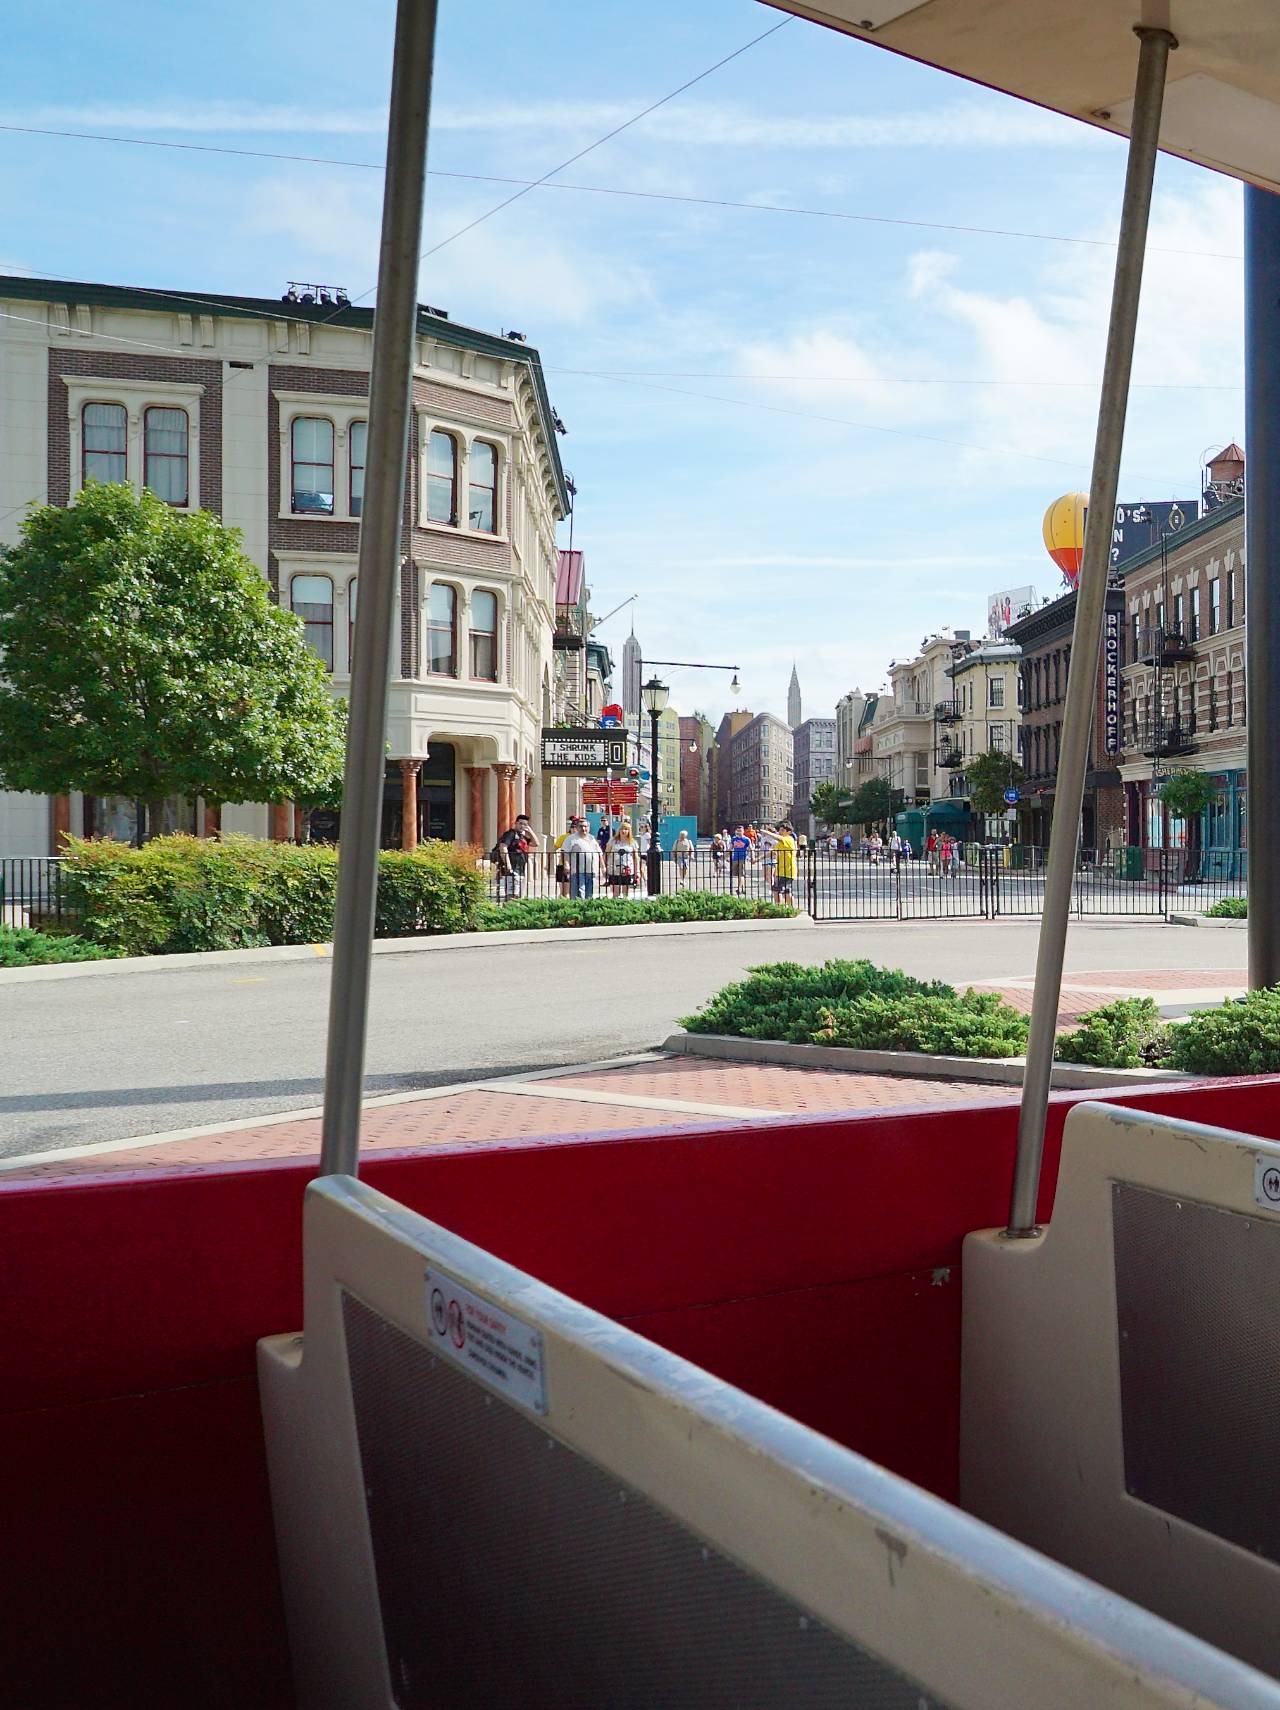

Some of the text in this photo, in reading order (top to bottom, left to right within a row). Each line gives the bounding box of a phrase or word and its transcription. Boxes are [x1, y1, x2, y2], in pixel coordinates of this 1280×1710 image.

[1107, 614, 1117, 748] BROCKERHOFF
[560, 744, 596, 752] SHRUNK
[550, 753, 597, 761] THE KIDS
